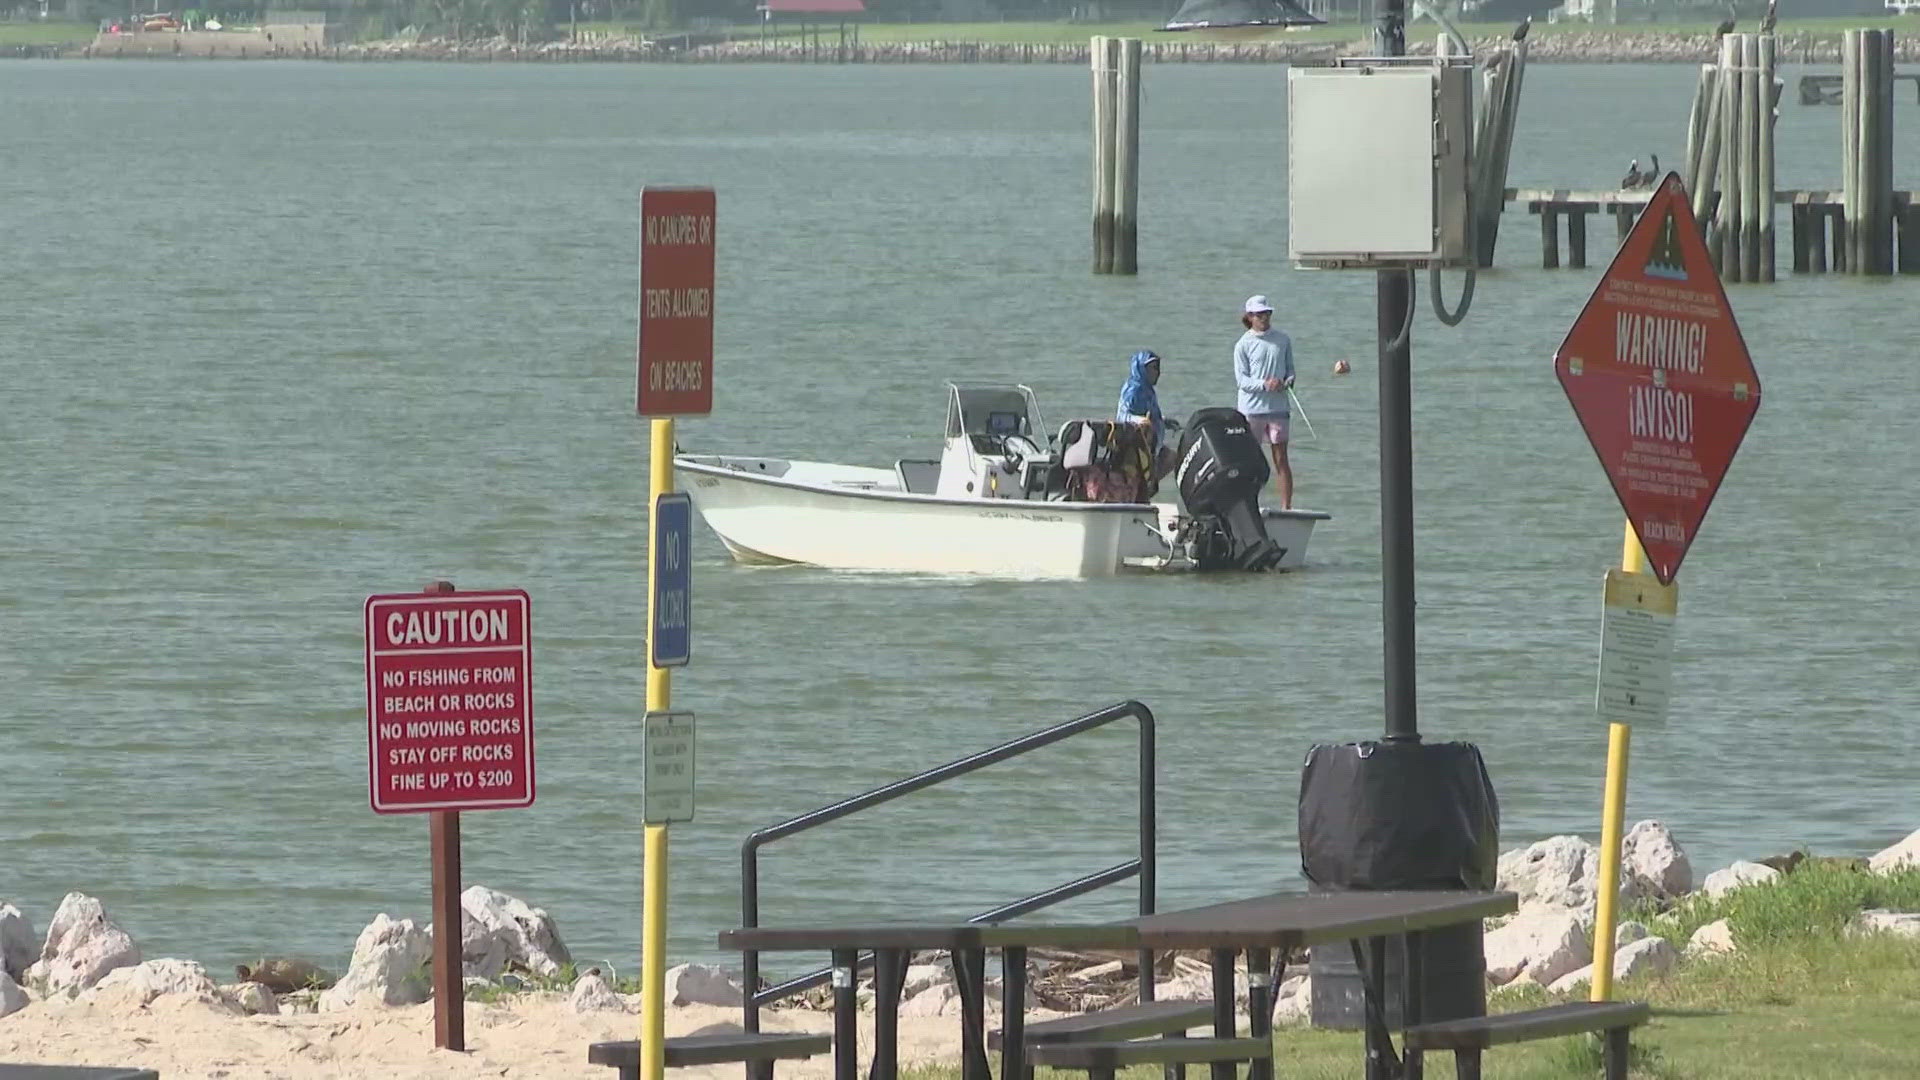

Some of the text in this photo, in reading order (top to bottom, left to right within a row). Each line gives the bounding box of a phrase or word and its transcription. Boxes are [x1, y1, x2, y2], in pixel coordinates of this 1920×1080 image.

[646, 215, 711, 246] NO CANOPIES OR
[646, 287, 710, 319] TENTS ALLOWED
[1616, 311, 1707, 374] WARNING!
[650, 360, 703, 392] ON BEACHES
[1628, 385, 1694, 443] ¡AVISO!
[665, 530, 680, 571] NO
[659, 590, 686, 630] ALCOHOL
[386, 608, 508, 645] CAUTION
[383, 666, 515, 688] NO FISHING FROM
[384, 692, 515, 713] BEACH OR ROCKS
[380, 717, 521, 740] NO MOVING ROCKS
[389, 743, 513, 765] STAY OFF ROCKS
[391, 769, 513, 791] FINE UP TO $200
